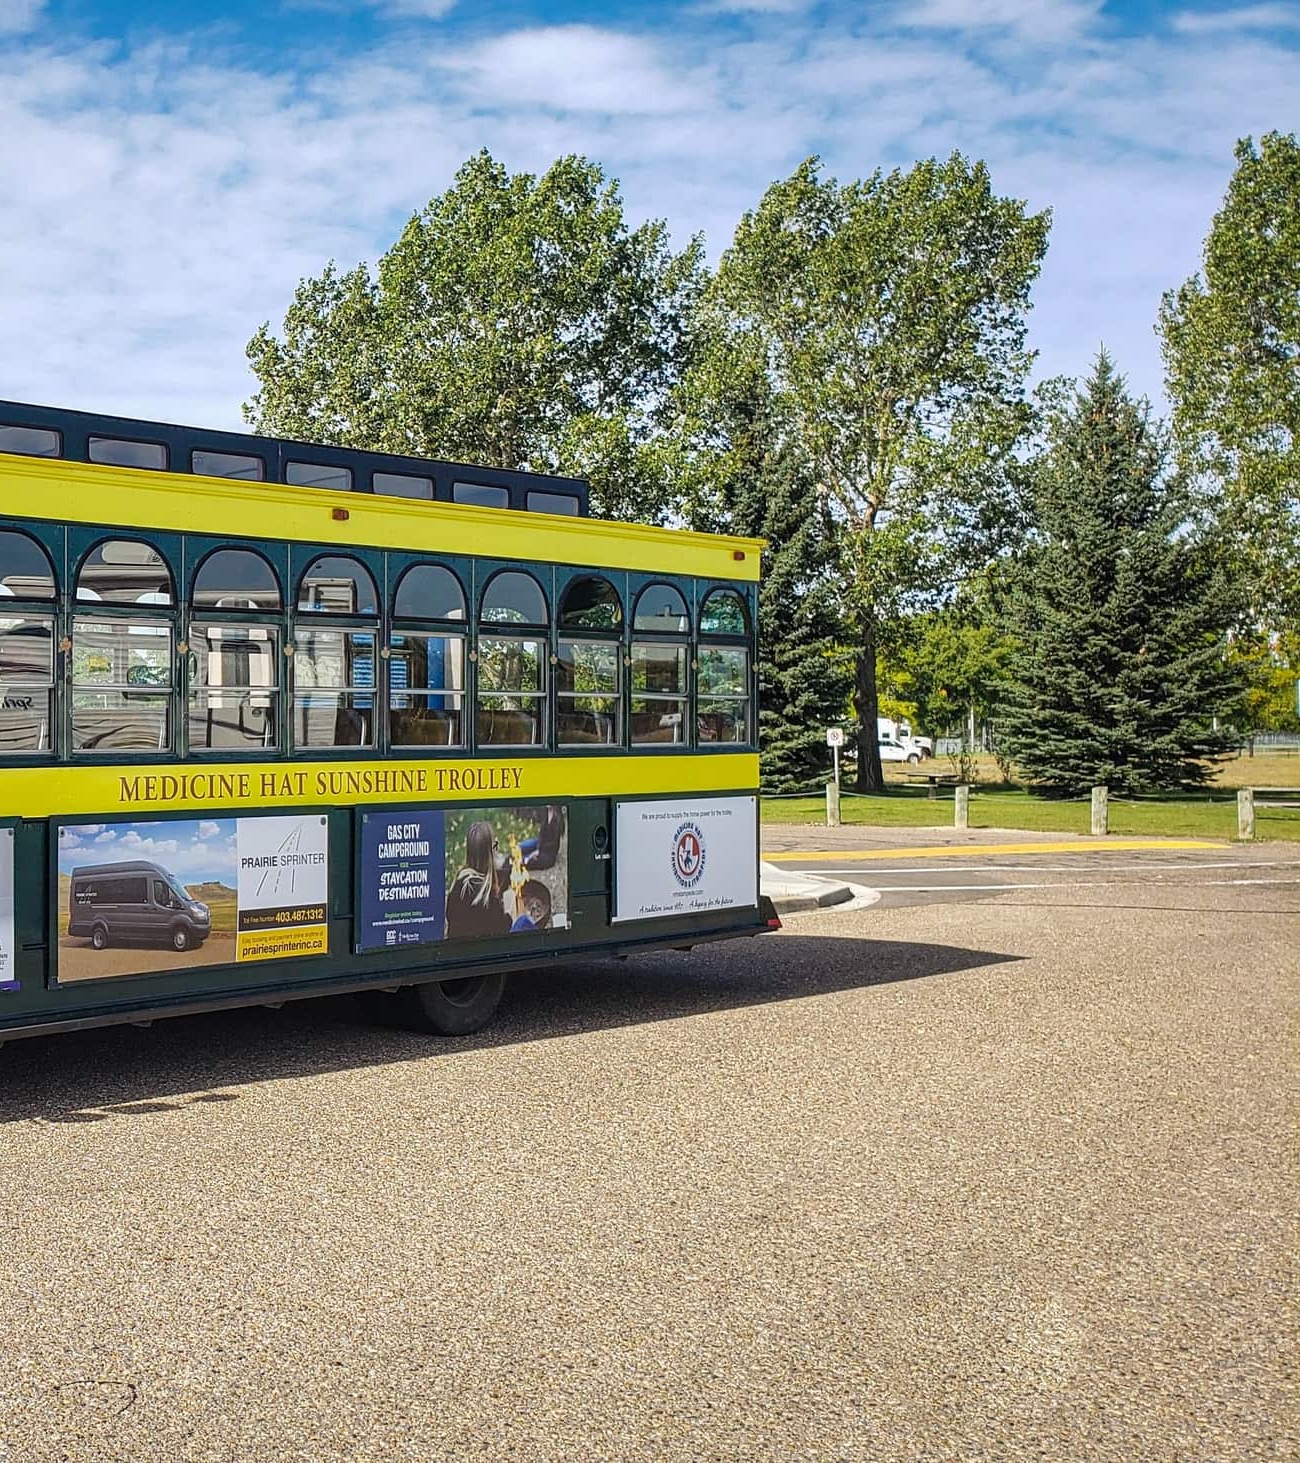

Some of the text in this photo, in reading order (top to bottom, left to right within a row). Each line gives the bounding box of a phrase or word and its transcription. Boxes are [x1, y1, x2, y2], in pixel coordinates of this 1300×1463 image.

[119, 767, 523, 801] MEDICINE HAT SUNSHINE TROLLEY
[388, 823, 420, 840] GAS CITY
[378, 841, 429, 858] CAMPGROUND
[241, 853, 325, 869] PRAIRIE SPRINTER
[380, 869, 428, 885] STAYCATION
[378, 885, 430, 901] DESTINATION
[275, 908, 323, 923] 403.487.1312
[243, 940, 322, 957] prairiesprinterinc.ca
